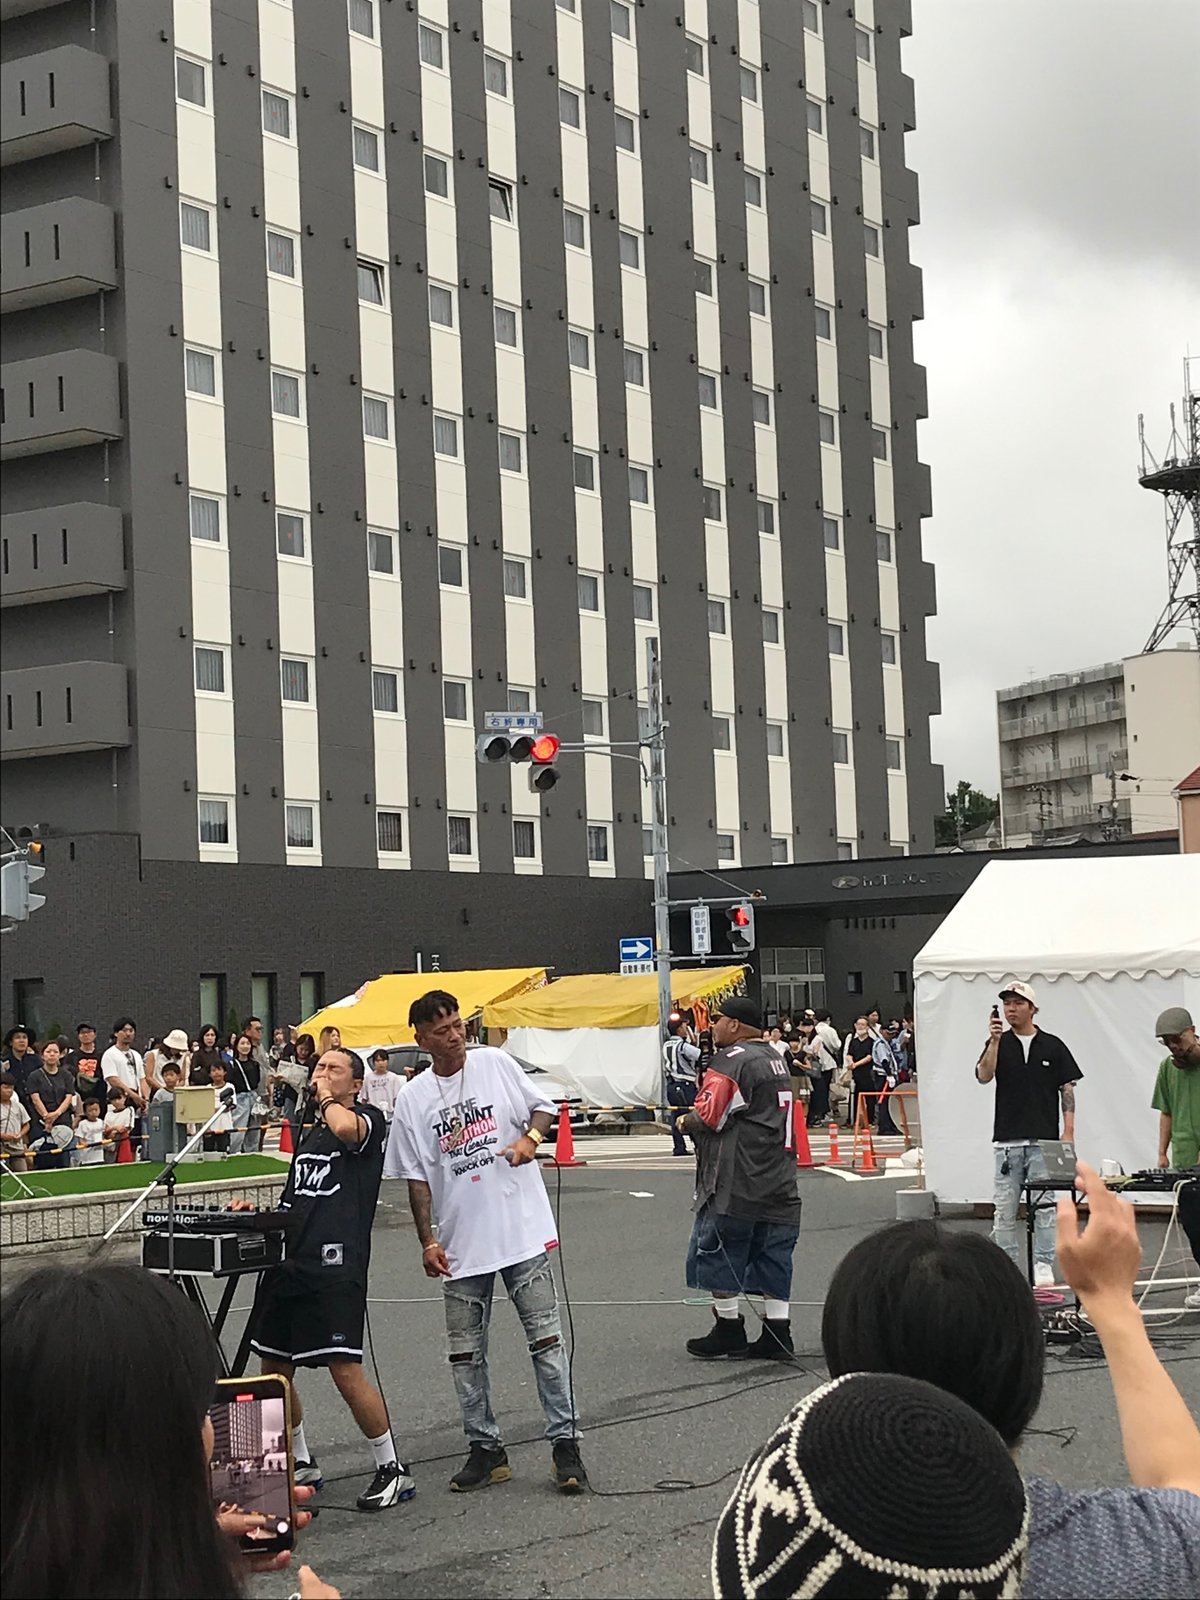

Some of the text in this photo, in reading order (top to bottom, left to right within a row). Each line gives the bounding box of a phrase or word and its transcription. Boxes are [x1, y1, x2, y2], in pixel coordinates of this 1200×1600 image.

[490, 717, 538, 727] 右折専用
[438, 1097, 478, 1122] IF THE
[777, 1090, 793, 1150] 7
[439, 1117, 497, 1153] MATHON
[146, 1214, 199, 1224] novtion
